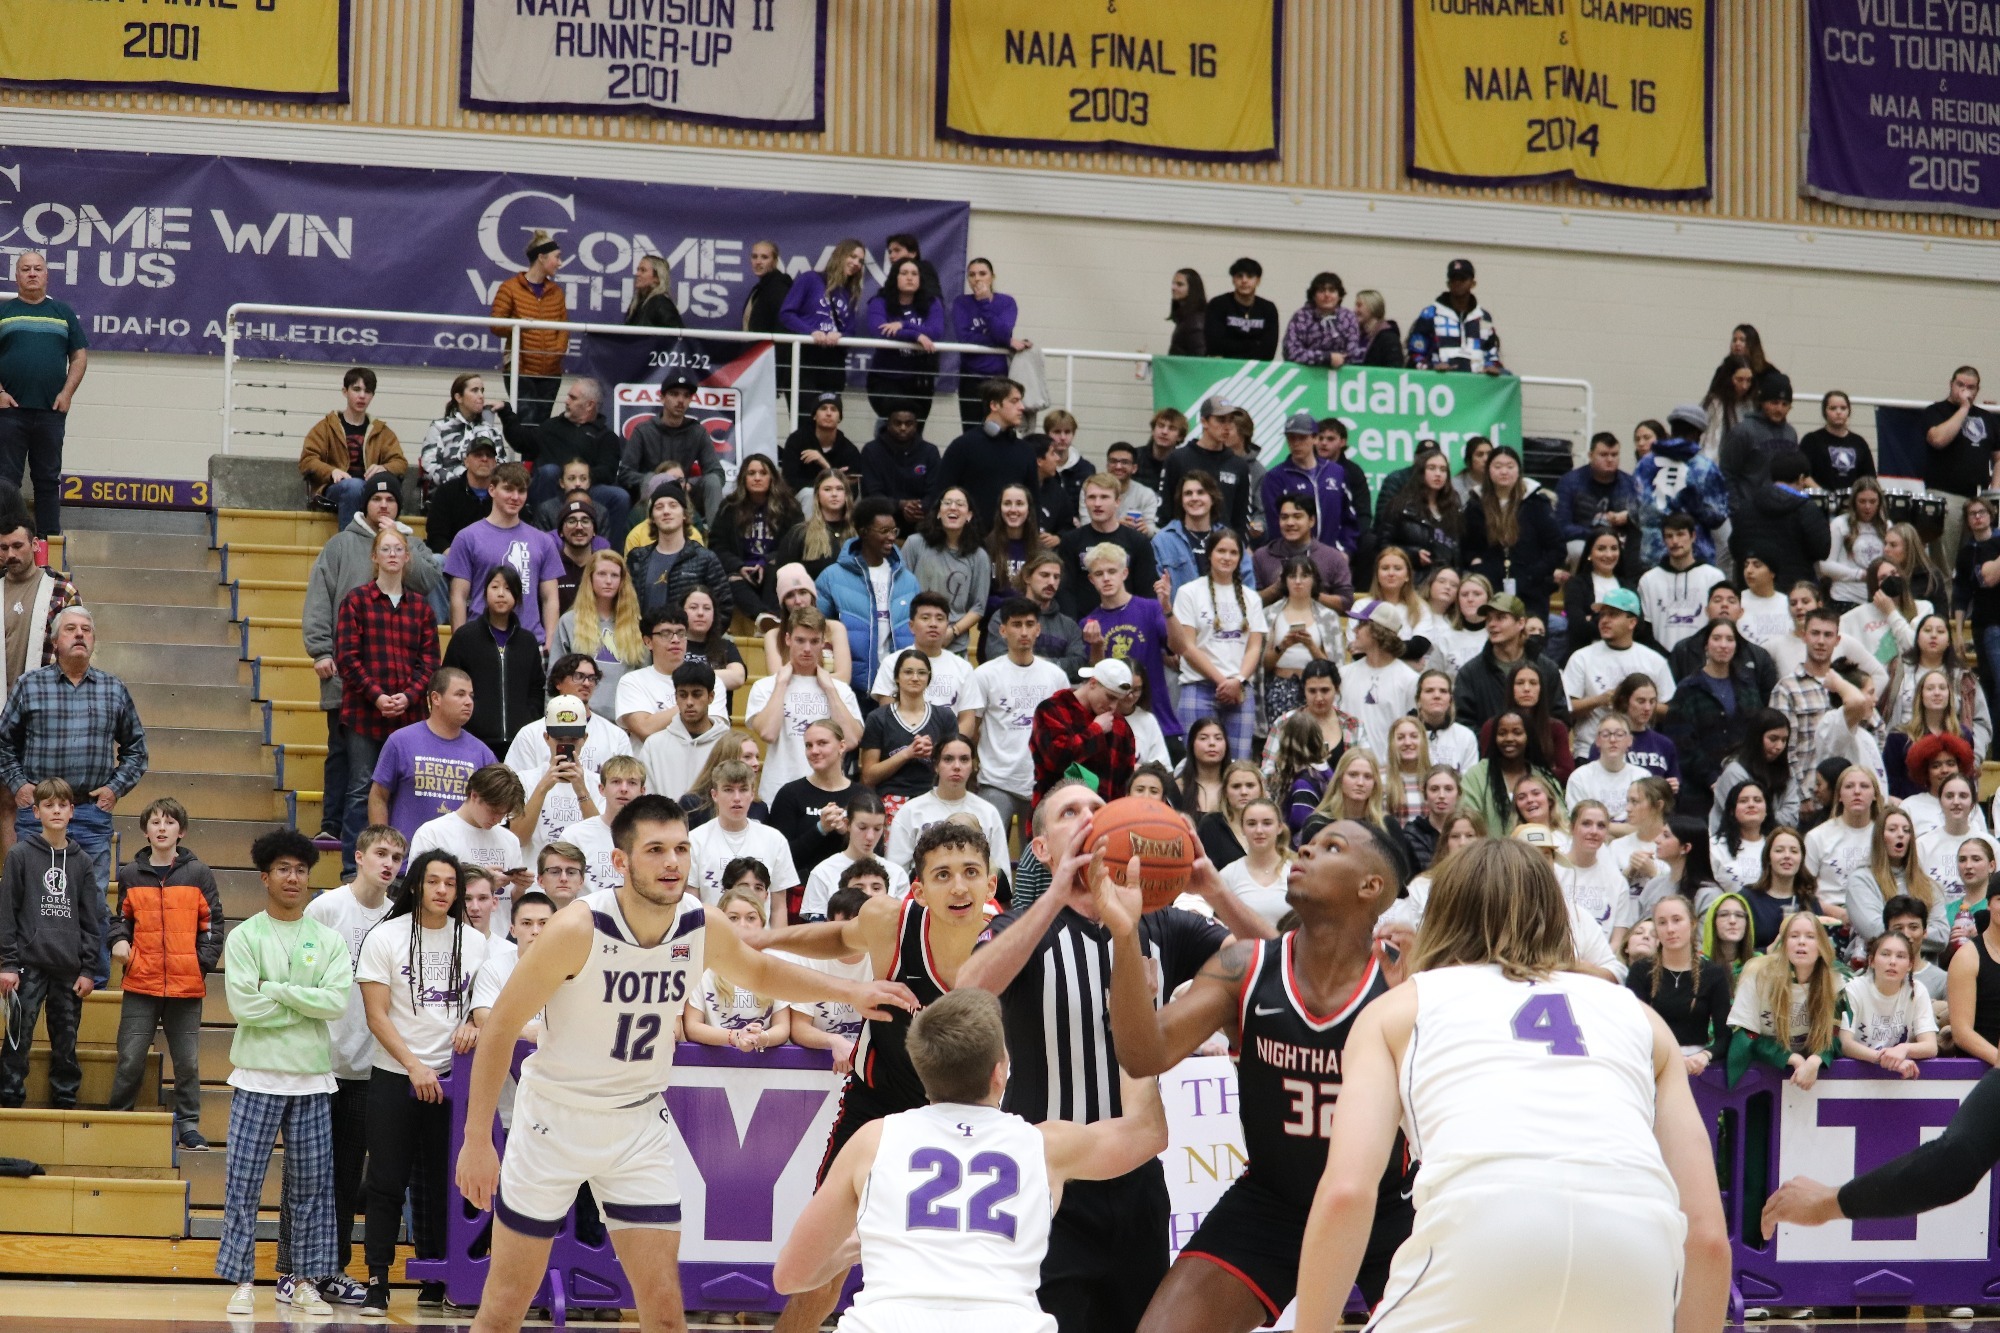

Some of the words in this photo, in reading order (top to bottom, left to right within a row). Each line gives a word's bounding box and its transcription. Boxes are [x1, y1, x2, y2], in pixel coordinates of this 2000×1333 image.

[1580, 0, 1692, 30] CHAMPIONS
[1857, 0, 2000, 37] VOLLEYBA
[124, 22, 200, 61] 2001
[555, 22, 732, 67] RUNNER-UP
[1005, 29, 1077, 68] NAIA
[1091, 33, 1176, 76] FINAL
[1189, 43, 1217, 78] 16
[1824, 27, 1875, 66] CCC
[608, 63, 679, 103] 2001
[1465, 66, 1532, 101] NAIA
[1544, 65, 1618, 109] FINAL
[1630, 79, 1656, 114] 16
[1069, 88, 1149, 126] 2003
[1870, 93, 1921, 120] NAIA
[1527, 117, 1600, 157] 2014
[1887, 124, 2000, 156] CHAMPIONS
[1908, 155, 1980, 194] 2005
[210, 208, 352, 260] WIN
[98, 251, 176, 289] US
[466, 269, 635, 313] WTH
[93, 315, 191, 337] IDAHO
[203, 320, 379, 347] ATHLETICS
[434, 332, 583, 357] COLE
[648, 351, 711, 370] 2021-22
[618, 388, 736, 408] CAADE
[1327, 370, 1455, 417] Idaho
[64, 477, 83, 499] 2
[91, 482, 174, 504] SECTION
[191, 482, 208, 505] 3
[1011, 685, 1047, 697] BEAT
[415, 761, 474, 780] LEGACY
[1627, 751, 1668, 771] OTES
[471, 848, 505, 861] BEAT
[40, 909, 72, 919] SCHOOL
[41, 896, 71, 906] FORGE
[602, 969, 686, 1004] YOTES
[610, 1012, 661, 1062] 12
[1510, 993, 1590, 1057] 4
[1256, 1036, 1343, 1075] NIGHTHA
[661, 1085, 831, 1242] Y
[906, 1146, 1020, 1243] 22
